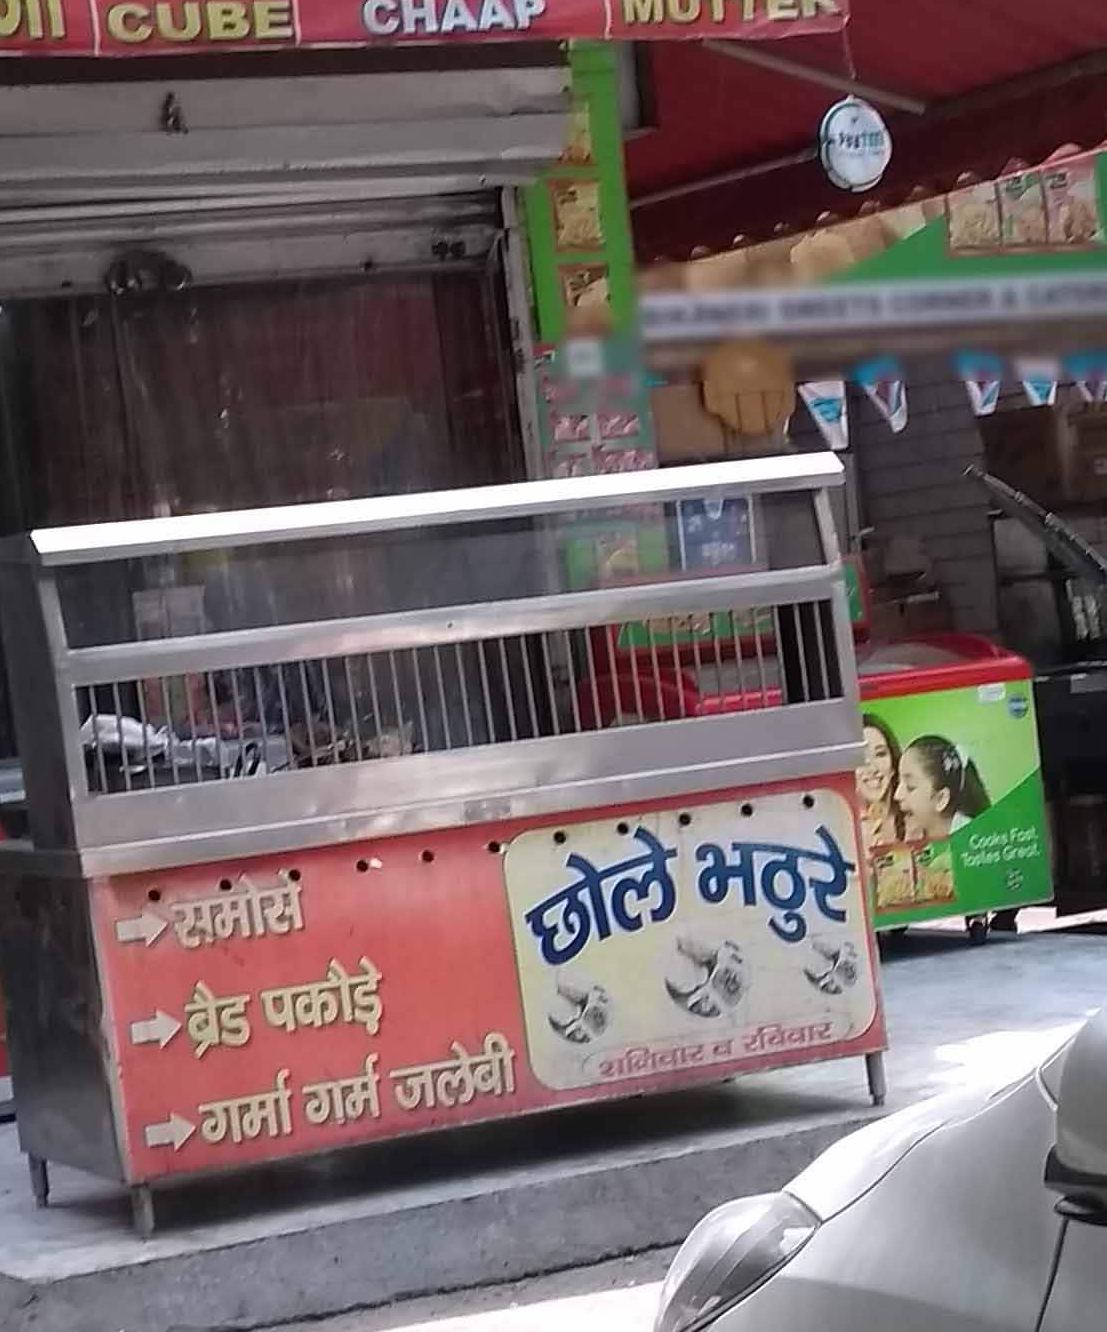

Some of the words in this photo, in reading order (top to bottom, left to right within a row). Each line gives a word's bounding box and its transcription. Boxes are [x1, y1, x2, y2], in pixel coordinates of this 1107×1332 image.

[107, 0, 294, 43] CUBE
[172, 868, 305, 949] समोसे
[524, 826, 678, 966] छोले
[302, 1052, 381, 1125] गर्म
[390, 1032, 516, 1109] जलेबी
